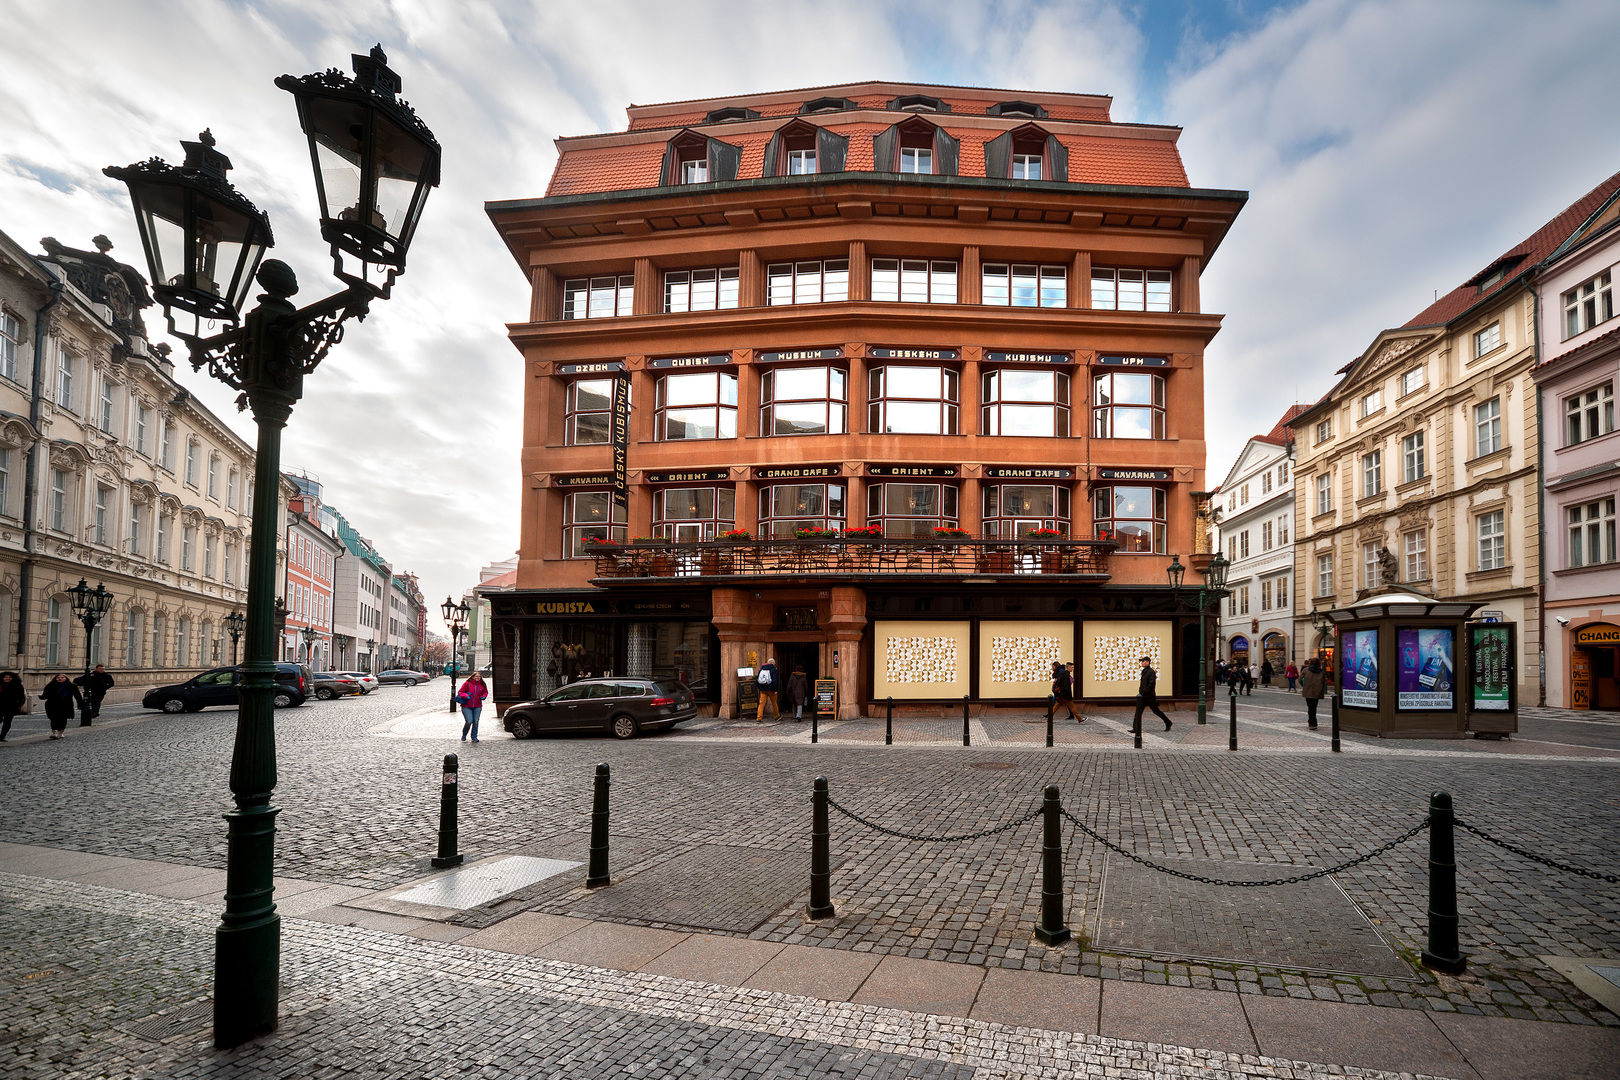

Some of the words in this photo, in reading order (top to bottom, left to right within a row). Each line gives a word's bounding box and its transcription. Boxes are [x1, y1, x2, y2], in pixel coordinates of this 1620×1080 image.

[778, 351, 821, 360] MUSEUM
[616, 378, 626, 443] KUBISMUS
[614, 446, 624, 489] ČESKÝ
[537, 602, 595, 613] KUBISTA
[1502, 684, 1508, 692] DU
[1574, 689, 1588, 703] 0%
